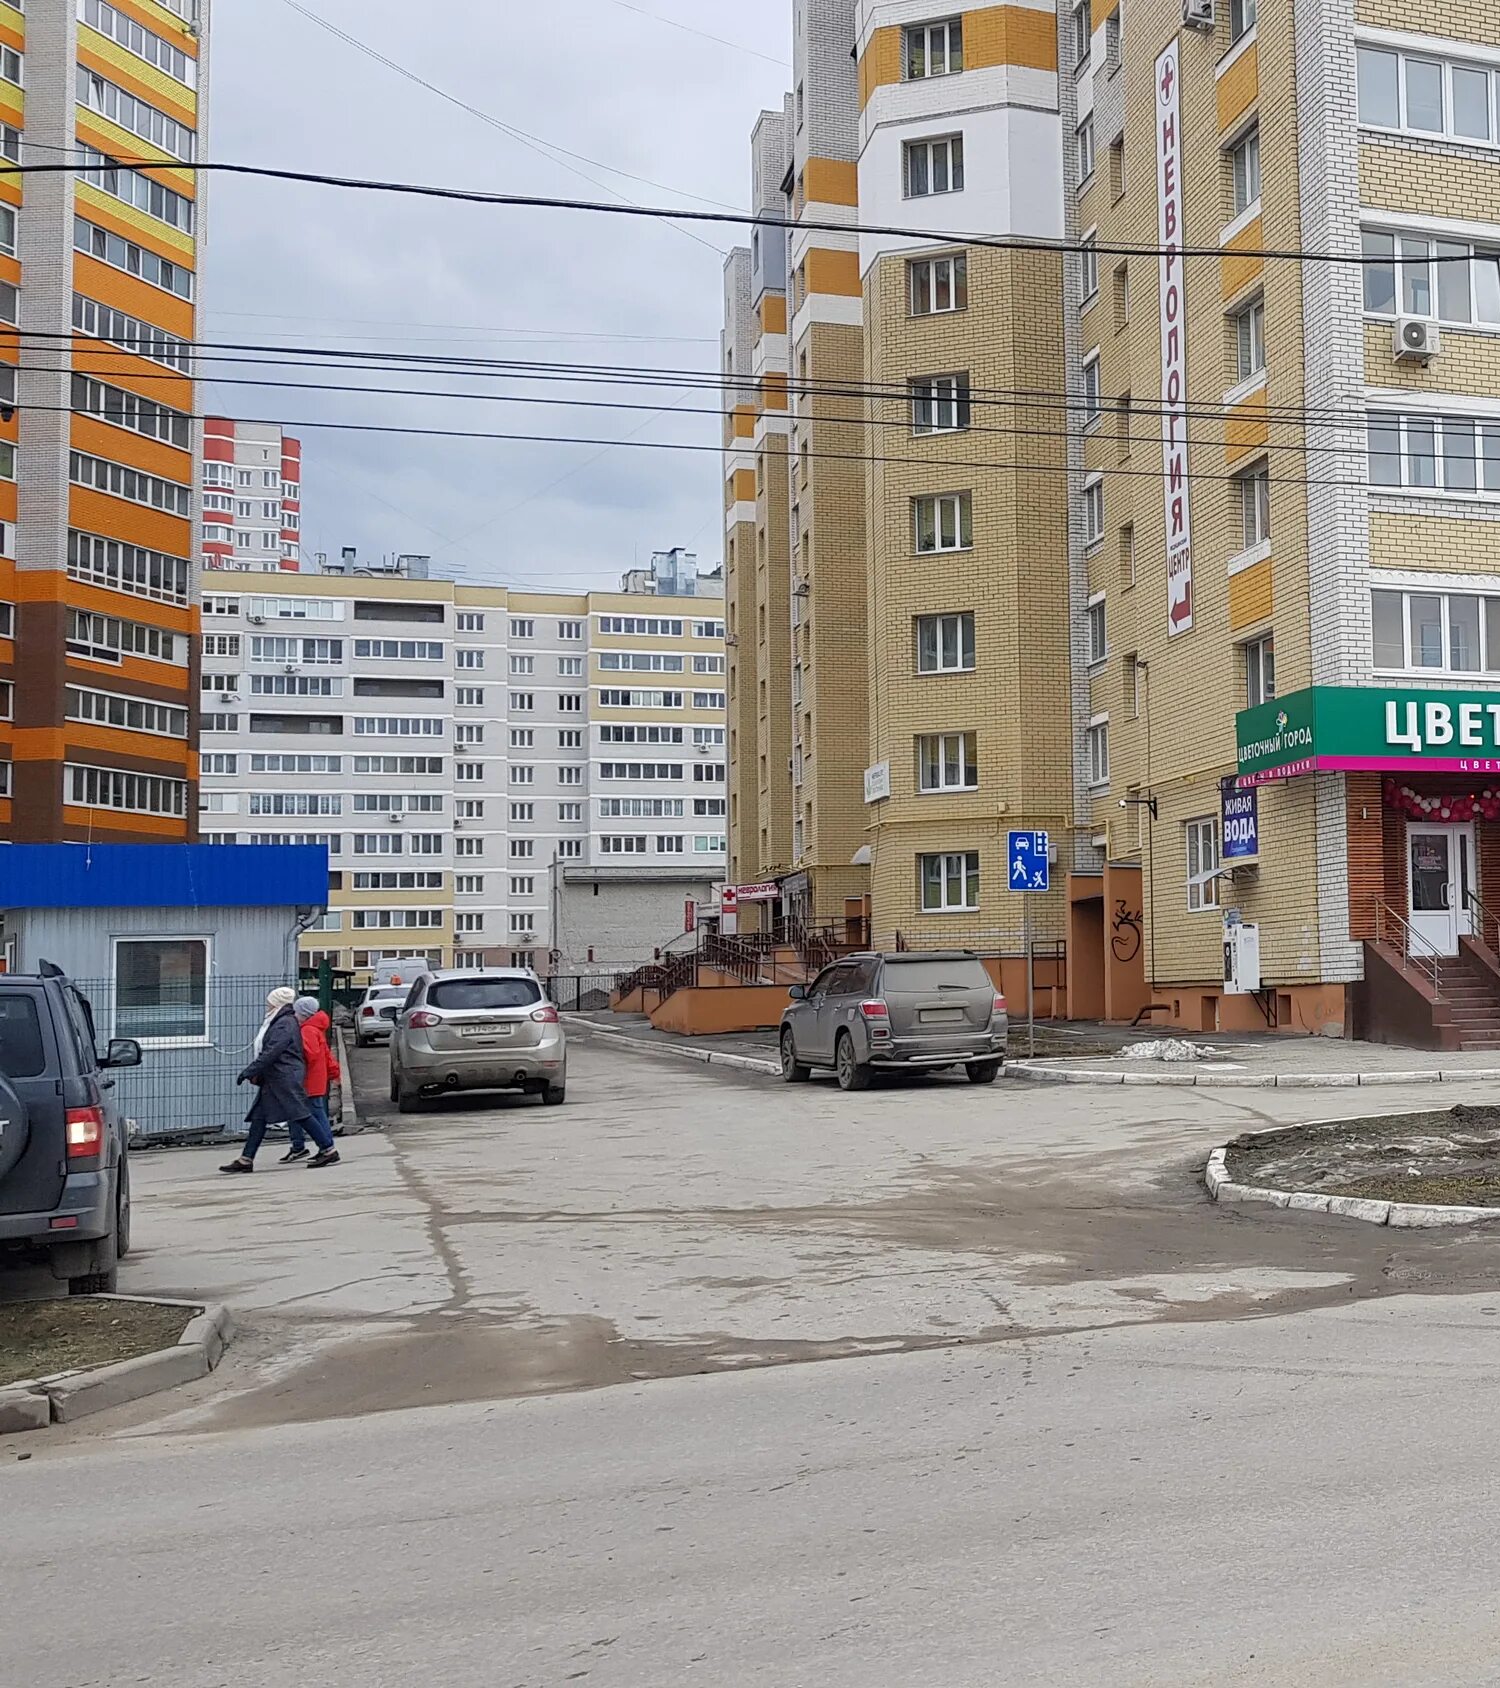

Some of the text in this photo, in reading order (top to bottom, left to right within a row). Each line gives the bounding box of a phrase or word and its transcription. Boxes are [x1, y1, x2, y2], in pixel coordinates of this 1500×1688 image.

[1162, 111, 1184, 537] НЕВРОЛОГИЯ
[1169, 547, 1189, 581] ЦЕНТР
[1238, 726, 1312, 763] ЦВЕТОЧНЫЙ ГОРОД
[1224, 796, 1252, 816] ЖИВАЯ
[1224, 817, 1256, 844] ВОДА
